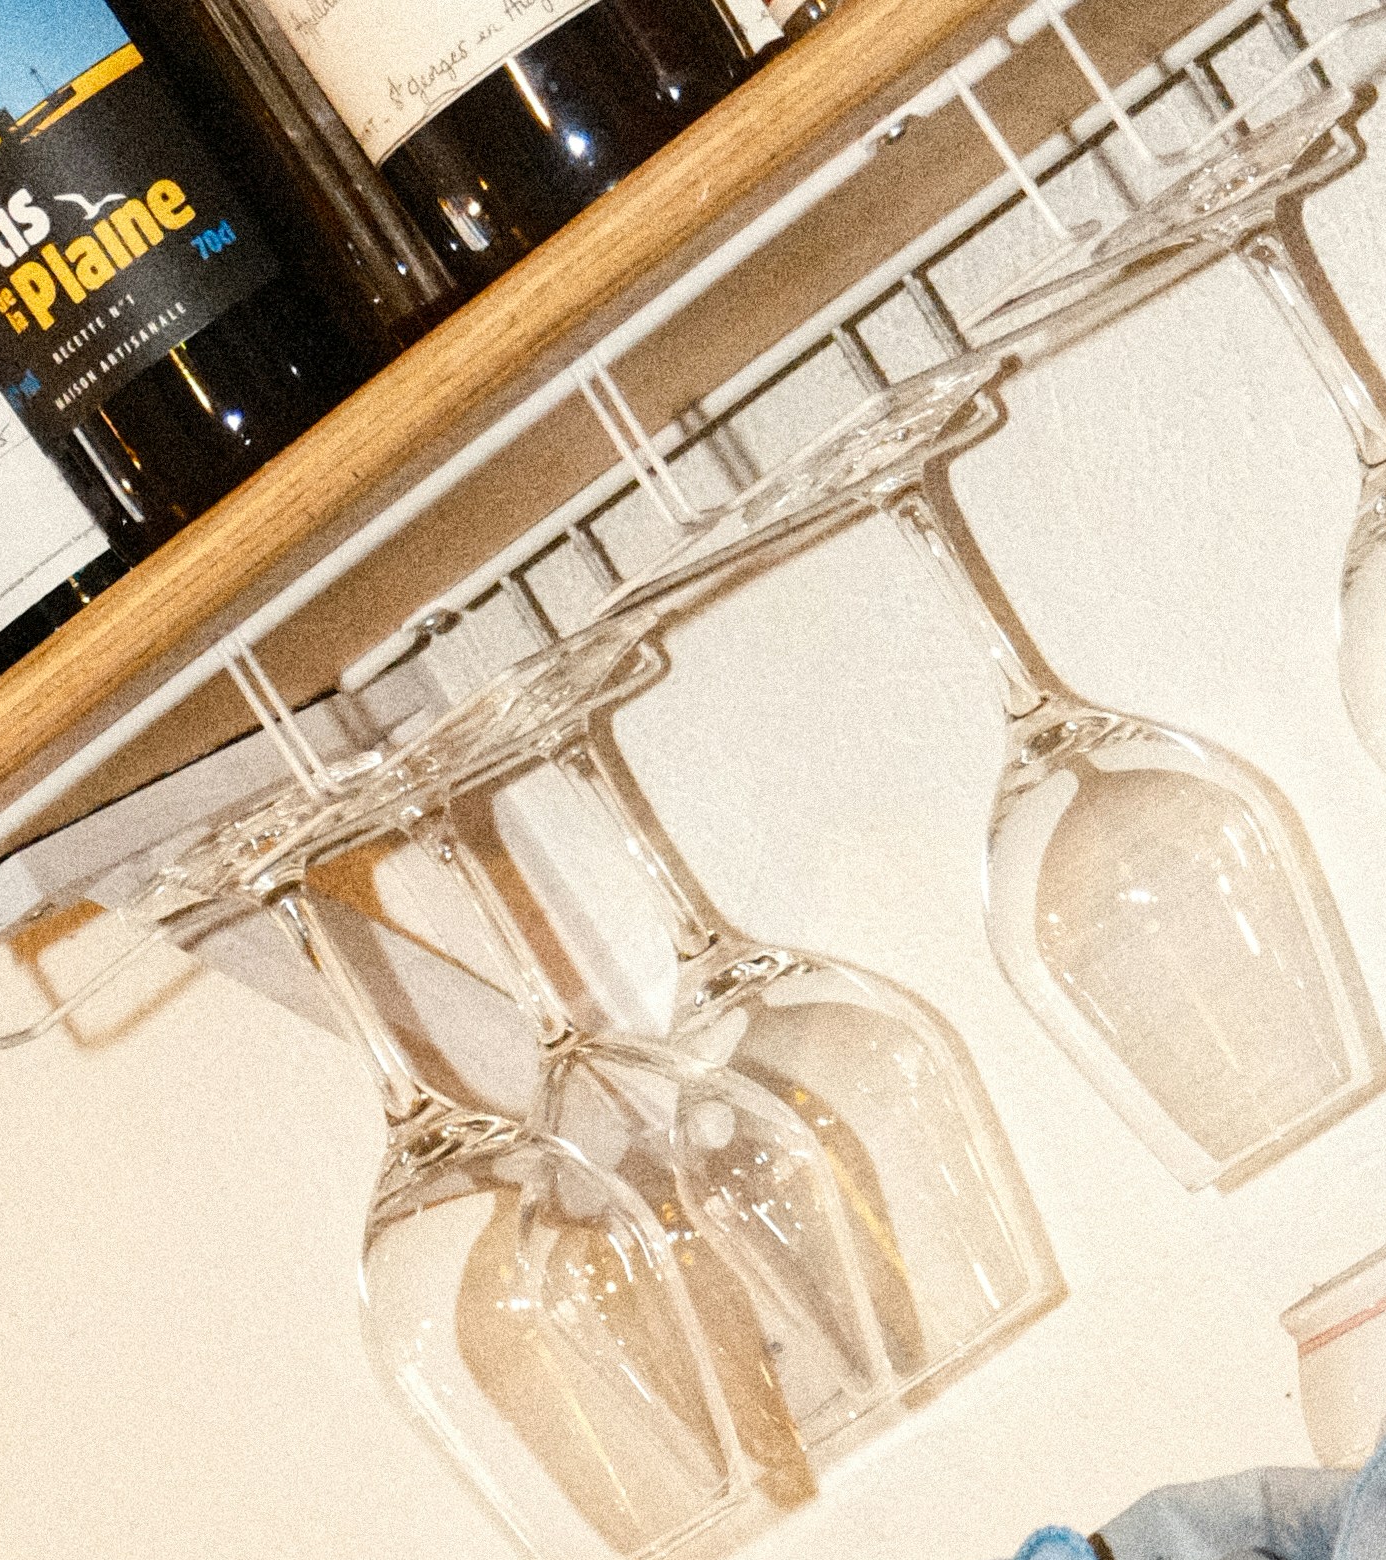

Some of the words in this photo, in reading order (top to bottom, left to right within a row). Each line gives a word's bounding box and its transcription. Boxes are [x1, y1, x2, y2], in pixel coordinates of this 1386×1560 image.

[18, 177, 196, 332] Plaine
[4, 306, 29, 336] la
[51, 316, 103, 365] RECETTE
[54, 369, 98, 411] MAISON
[99, 301, 187, 372] ARTISANALE
